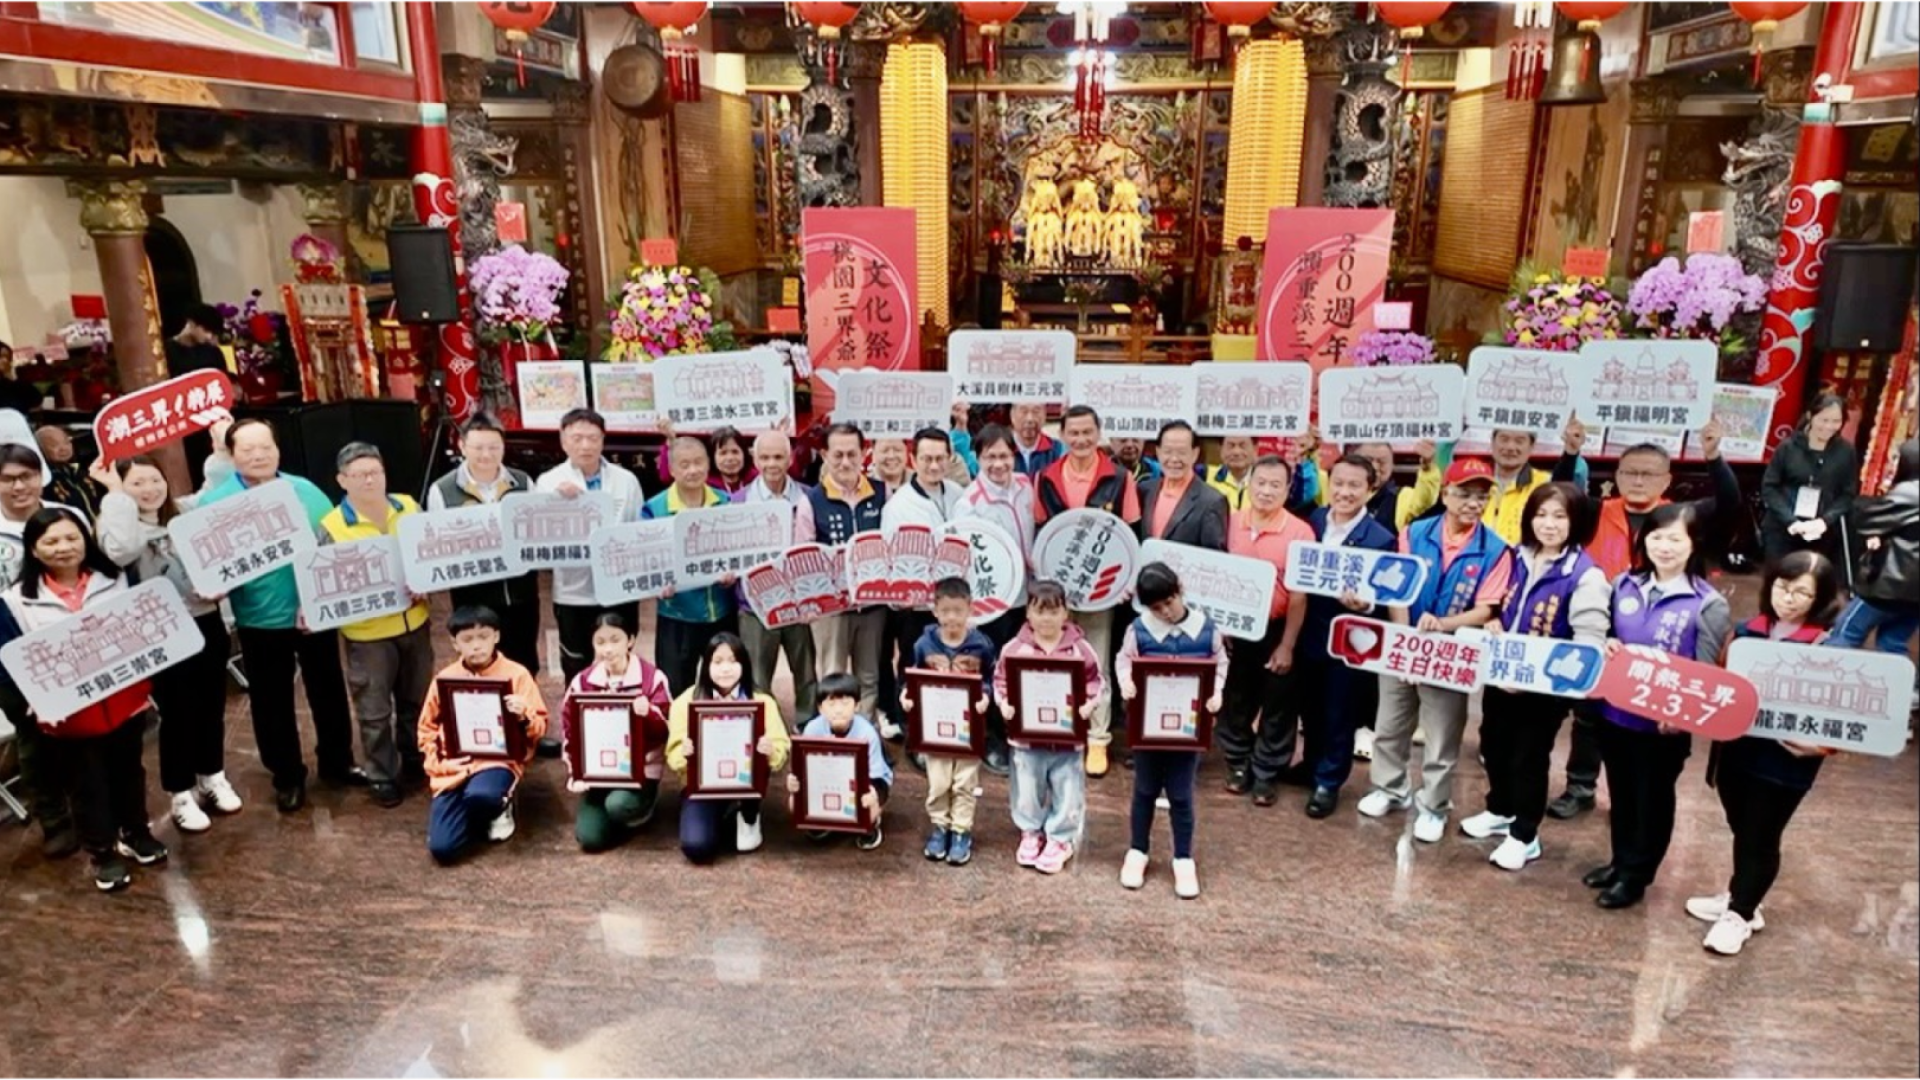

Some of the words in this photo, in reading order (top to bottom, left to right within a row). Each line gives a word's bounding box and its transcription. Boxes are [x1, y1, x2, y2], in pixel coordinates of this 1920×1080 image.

[834, 241, 856, 361] 桃園三界爺
[864, 261, 892, 358] 文化祭
[1290, 251, 1322, 362] 頭重溪三
[957, 381, 1064, 396] 大溪員樹林三元宮
[1328, 421, 1452, 438] 平鎮山仔頂福林宮
[1478, 406, 1560, 429] 平鎮鎮安宮
[1597, 404, 1689, 425] 平鎮福明宮
[218, 539, 294, 582] 大溪永安宮
[969, 533, 998, 597] 文化祭
[1299, 547, 1364, 574] 頭重溪
[1296, 568, 1362, 593] 三元宮
[319, 591, 397, 622] 八德三元宮
[1393, 633, 1481, 665] 200週年
[76, 646, 168, 699] 平鎮三崇宮
[1386, 651, 1477, 687] 生日快樂
[1630, 684, 1717, 726] 2.3.7
[1755, 708, 1867, 742] 龍潭永福宮
